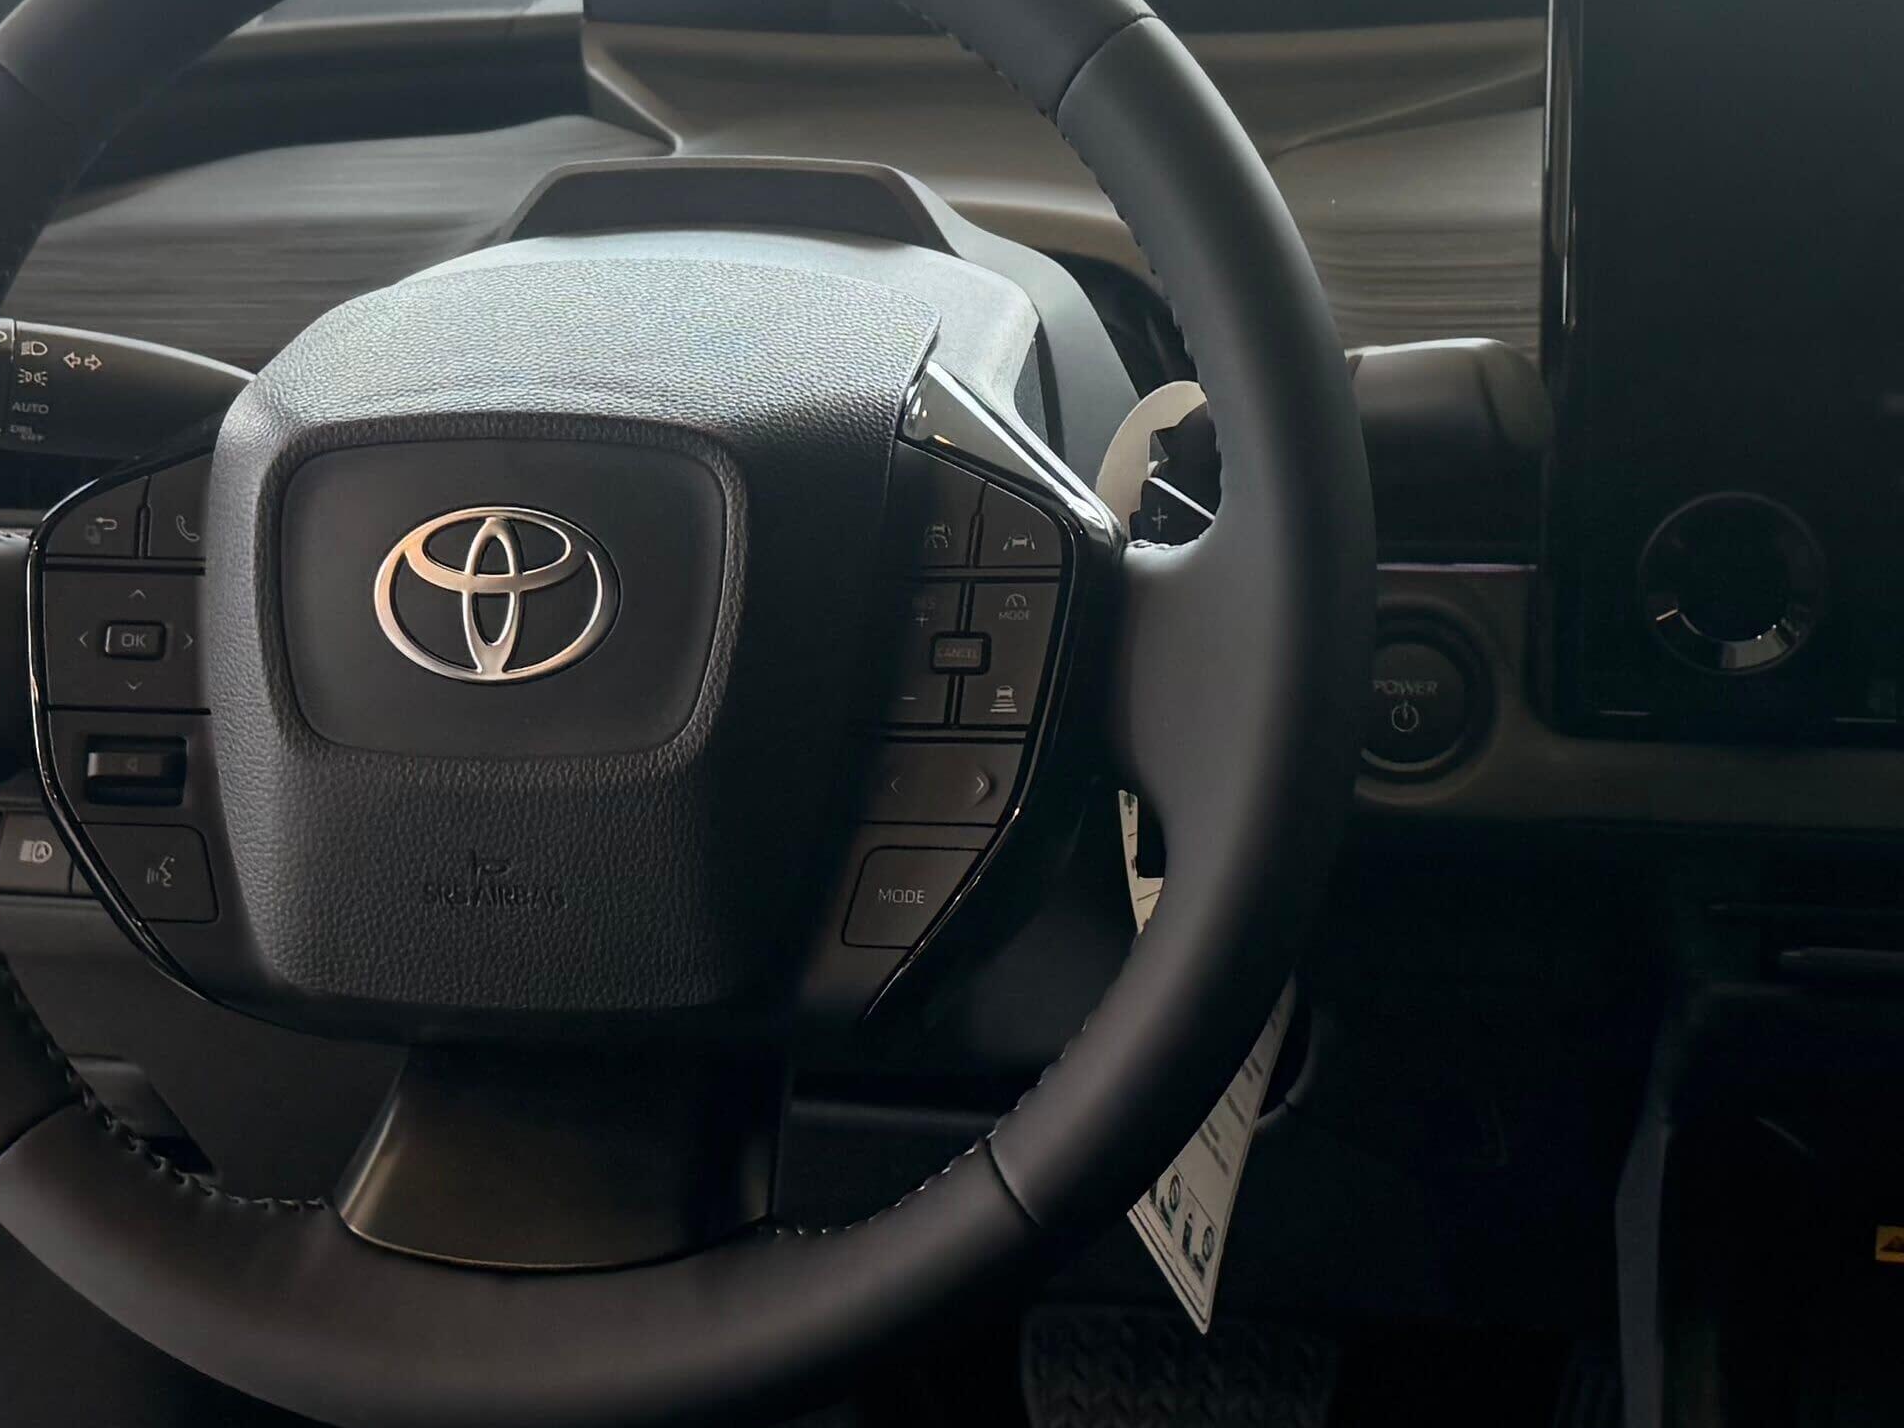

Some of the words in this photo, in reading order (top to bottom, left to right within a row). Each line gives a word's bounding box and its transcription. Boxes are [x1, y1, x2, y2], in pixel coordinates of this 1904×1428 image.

[12, 401, 49, 415] AUTO
[998, 609, 1031, 621] MODE
[120, 632, 147, 649] OK
[877, 888, 926, 904] MODE
